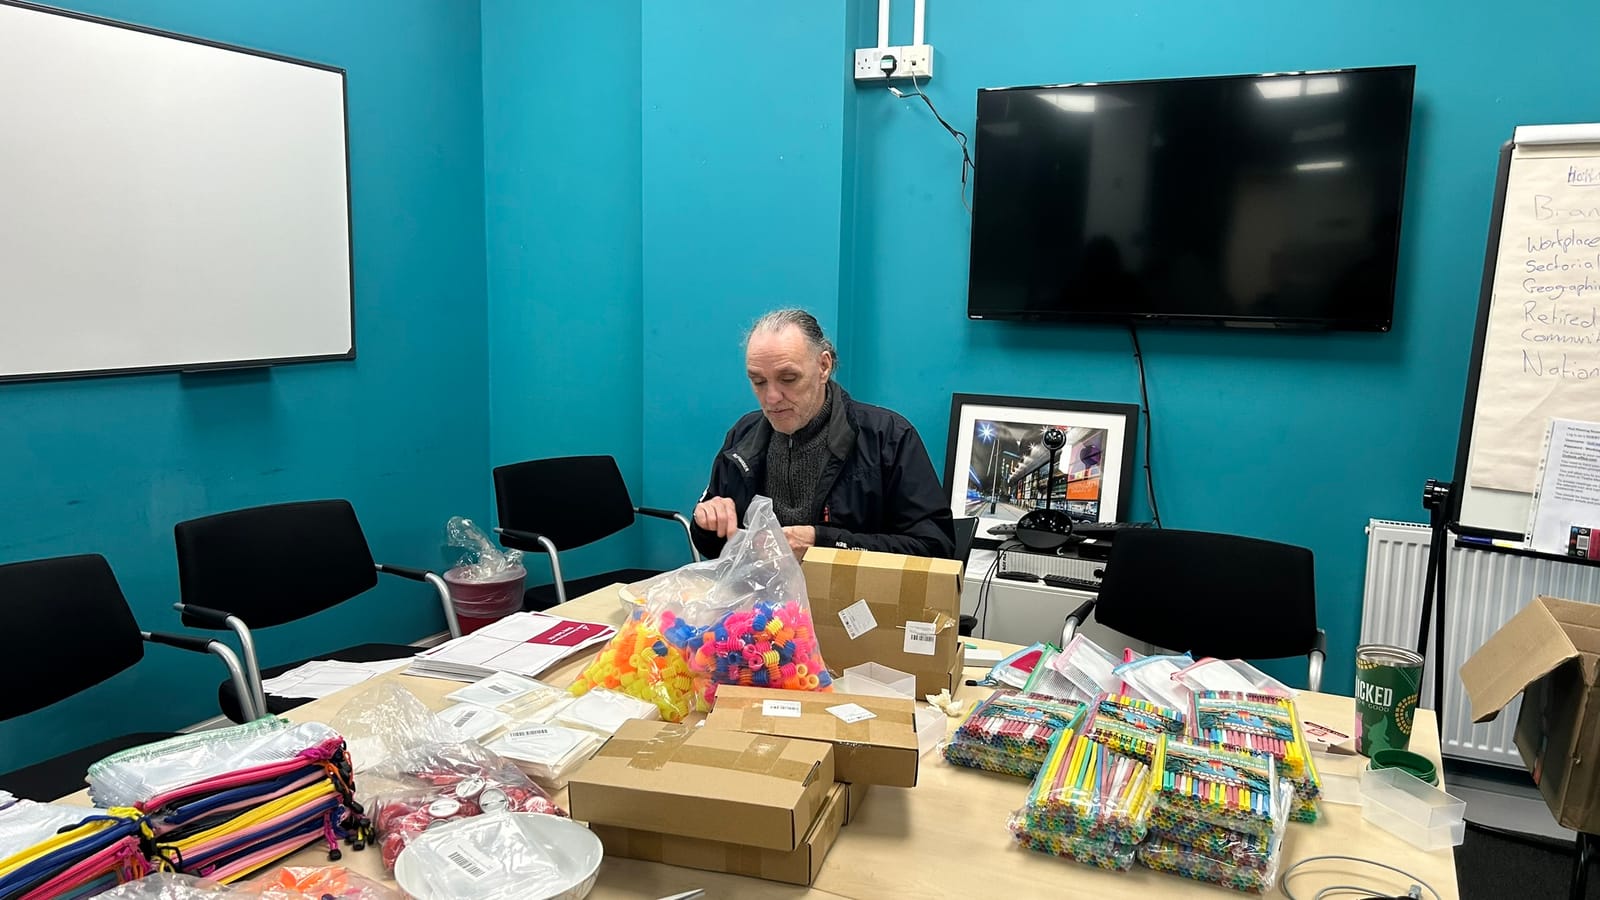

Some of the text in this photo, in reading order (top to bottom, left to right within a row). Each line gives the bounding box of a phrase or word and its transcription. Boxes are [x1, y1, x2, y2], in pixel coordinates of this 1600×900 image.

[1527, 228, 1600, 253] Workplace
[1526, 254, 1600, 273] Sectorial
[1522, 276, 1600, 300] Geographi
[1523, 300, 1596, 328] Retired
[1355, 674, 1393, 707] ICKED
